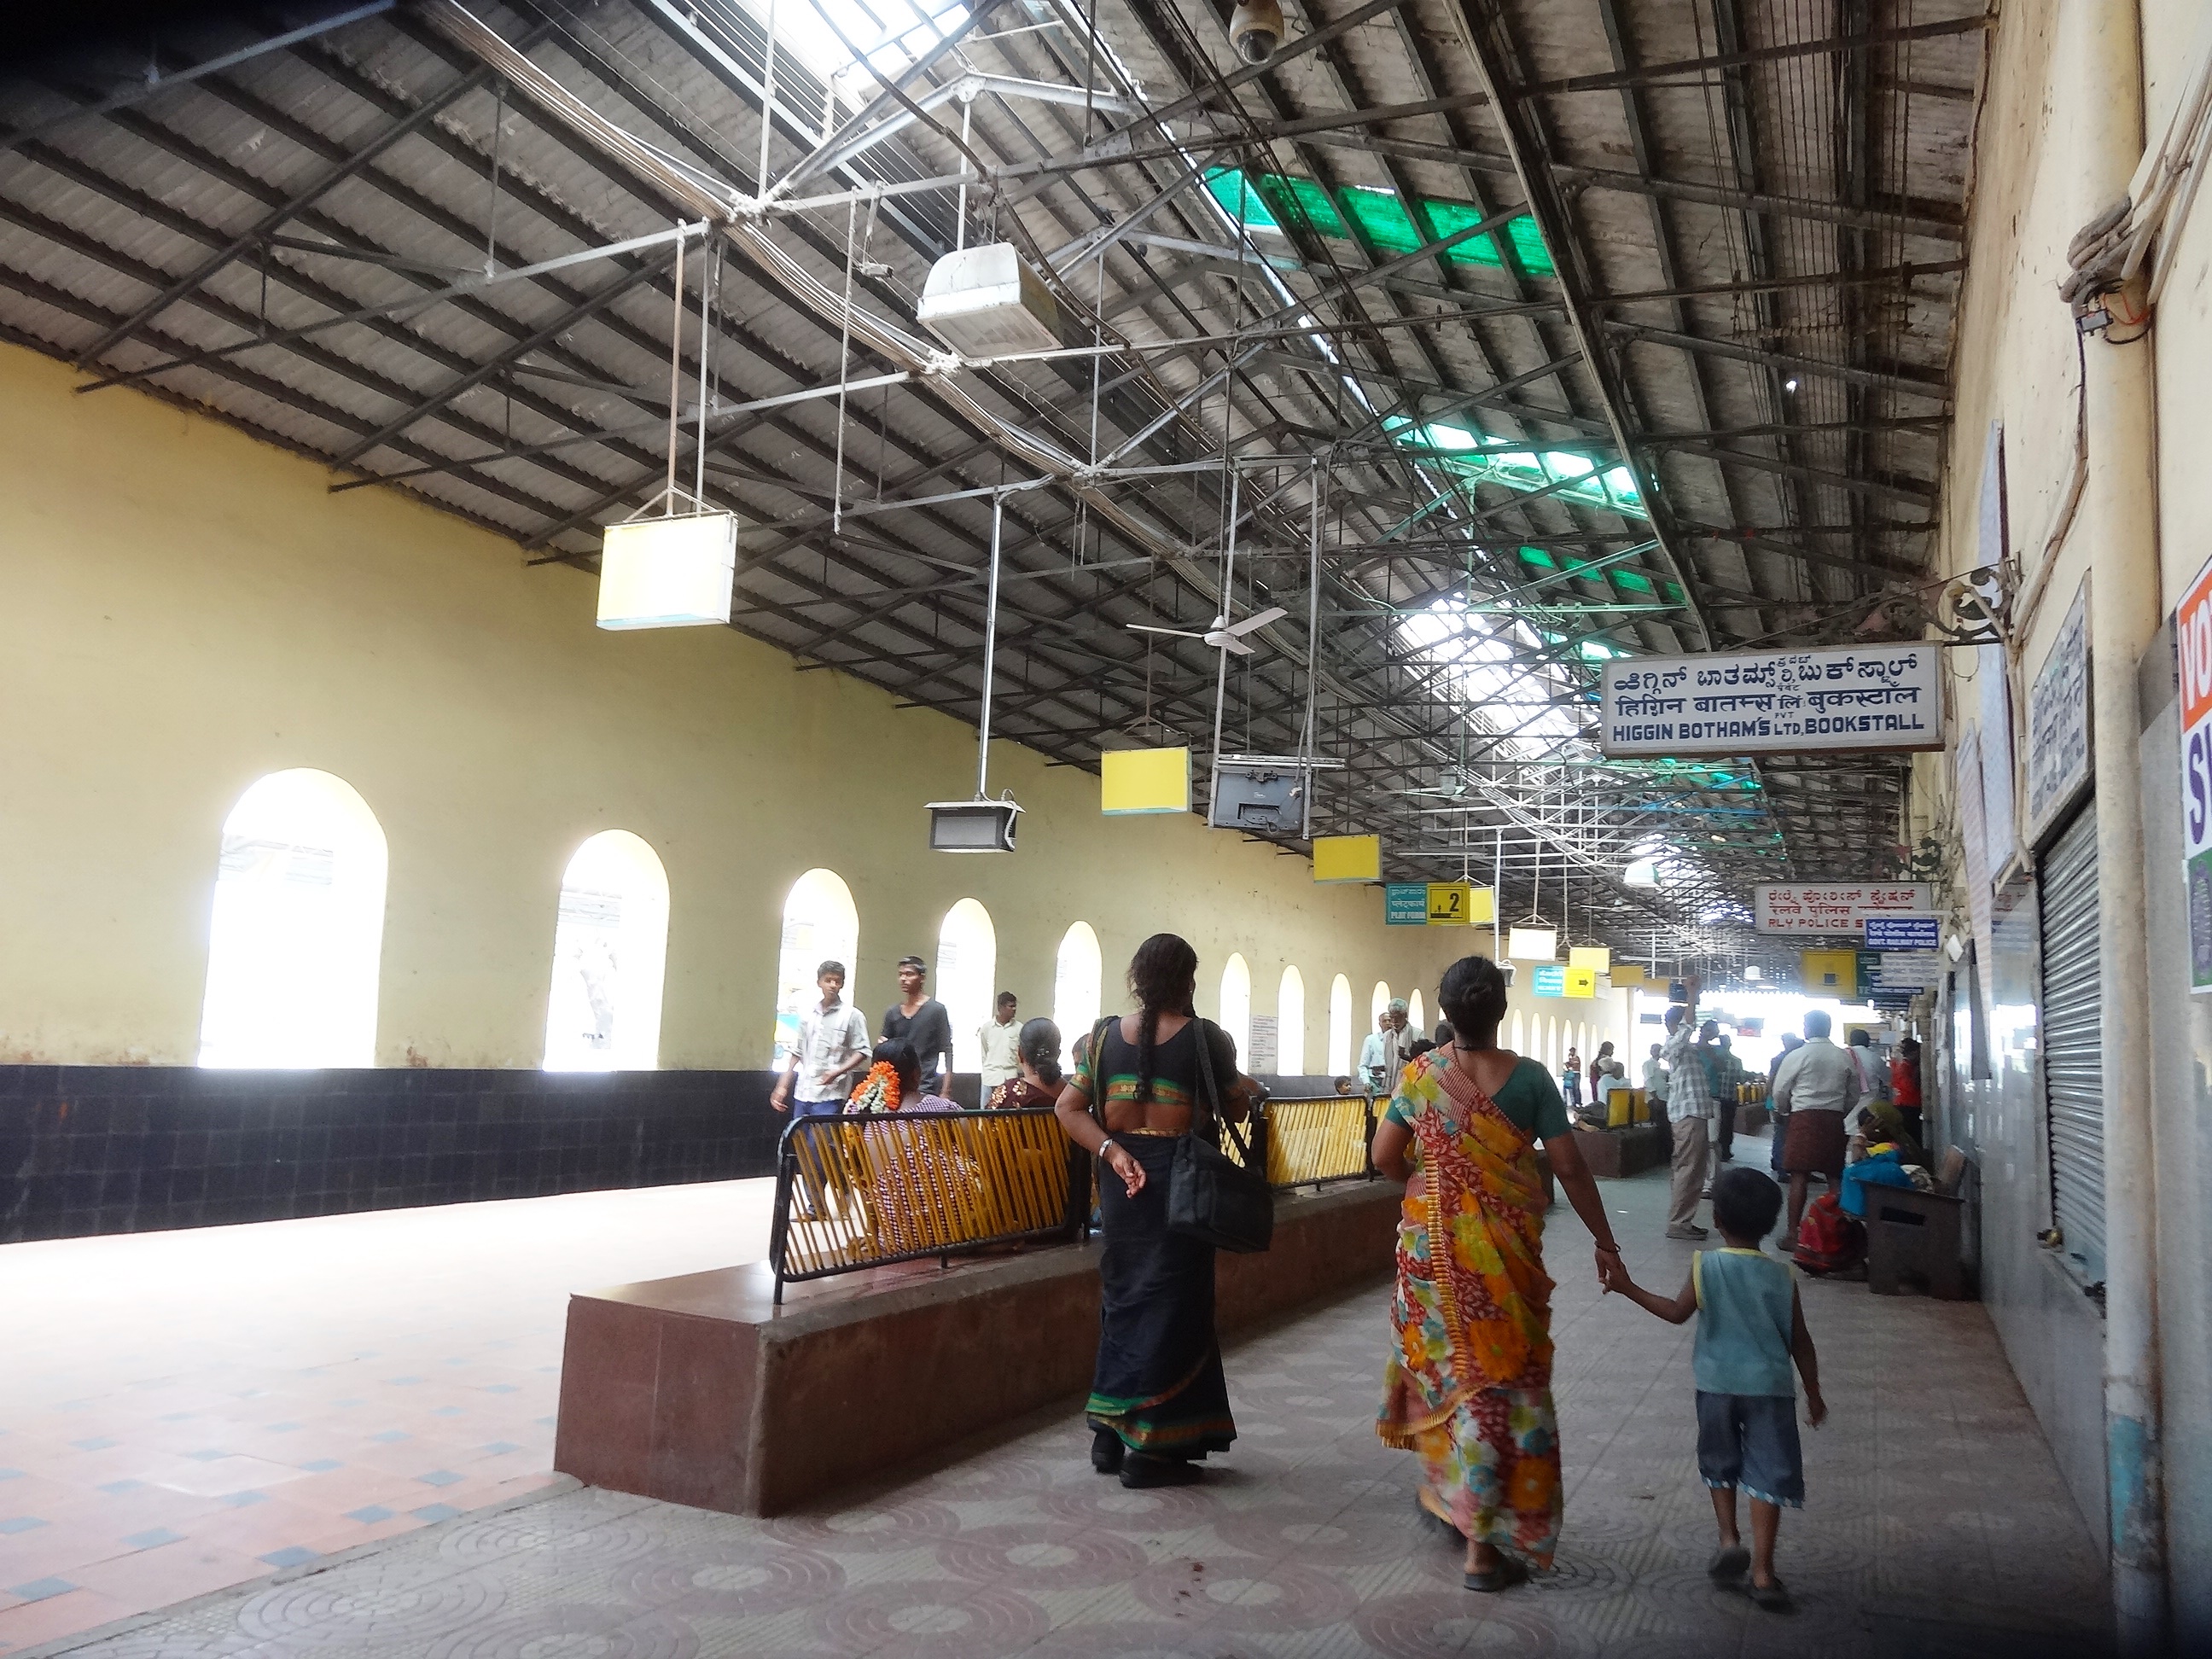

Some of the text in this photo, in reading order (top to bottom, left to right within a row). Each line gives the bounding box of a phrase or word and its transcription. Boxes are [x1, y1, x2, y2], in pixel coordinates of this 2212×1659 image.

[1613, 723, 1674, 742] HIGGIN
[1679, 716, 1772, 740] BOTHAM'S
[1805, 713, 1925, 735] BOOKSTALL
[1449, 893, 1459, 912] 2
[1768, 918, 1793, 928] RLY
[1798, 918, 1848, 928] POLICE
